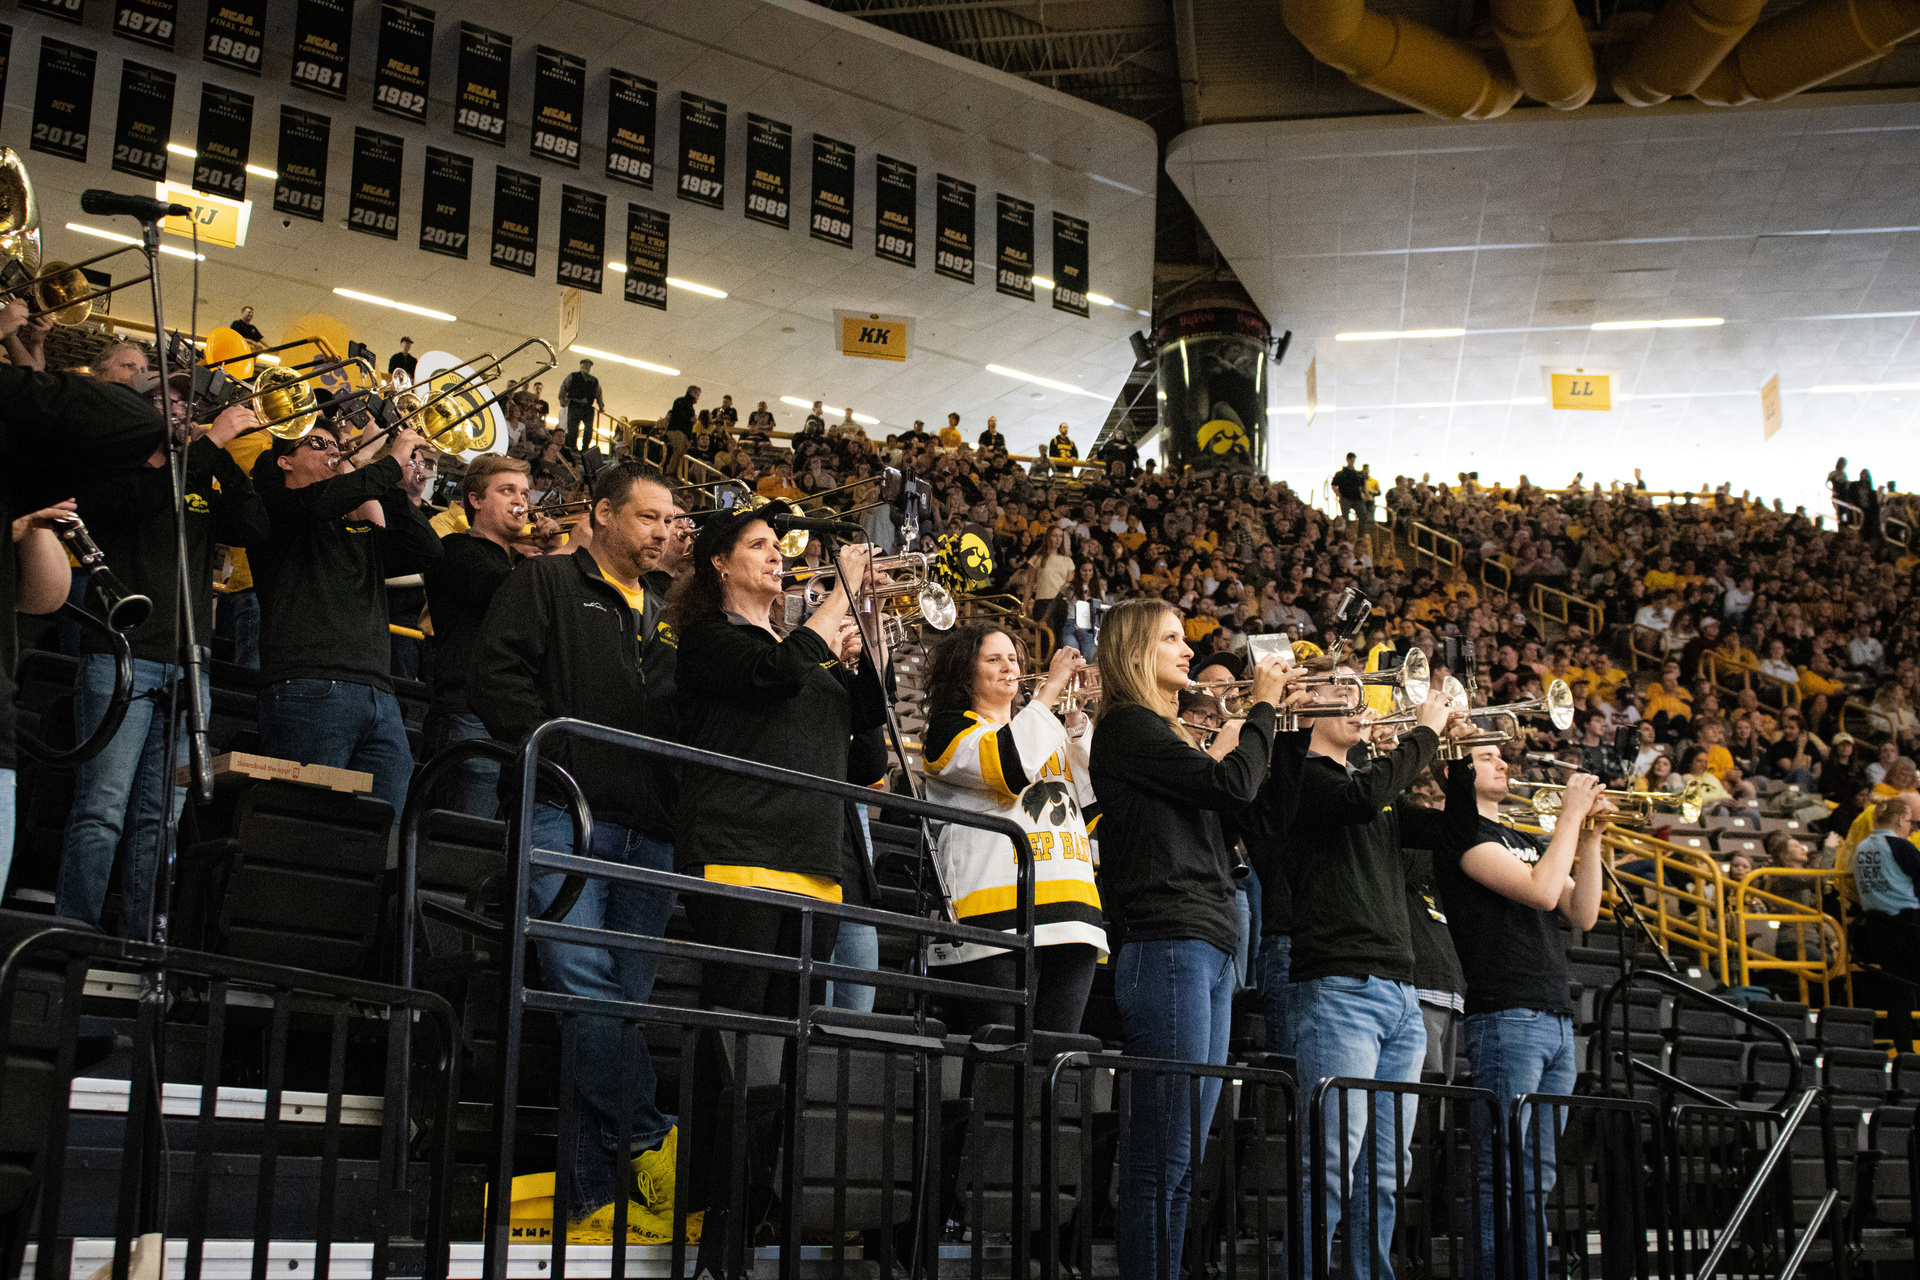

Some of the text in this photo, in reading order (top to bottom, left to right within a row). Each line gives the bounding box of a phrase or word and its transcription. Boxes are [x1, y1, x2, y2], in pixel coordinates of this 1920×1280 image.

[118, 9, 173, 38] 1979
[219, 8, 254, 26] NCAA
[210, 17, 260, 38] FINAL FOUR
[208, 34, 260, 63] 1980
[299, 44, 344, 62] TOURNAMENT
[305, 34, 338, 52] NCAA
[295, 62, 343, 88] 1981
[381, 68, 426, 86] TOURNAMENT
[387, 58, 420, 77] NCAA
[378, 85, 426, 113] 1982
[466, 82, 497, 100] NCAA
[458, 108, 504, 134] 1983
[537, 116, 578, 132] TOURNAMENT
[542, 106, 572, 123] NCAA
[33, 122, 87, 150] 2012
[534, 131, 578, 158] 1985
[616, 128, 645, 144] NCAA
[114, 144, 166, 170] 2013
[208, 142, 238, 158] NCAA
[688, 150, 716, 166] NCAA
[287, 163, 316, 178] NCAA
[608, 153, 652, 178] 1986
[195, 166, 244, 192] 2014
[682, 174, 722, 198] 1987
[755, 170, 782, 186] NCAA
[276, 186, 324, 210] 2015
[361, 184, 390, 198] NCAA
[820, 190, 844, 206] NCAA
[749, 194, 788, 218] 1988
[351, 208, 397, 230] 2016
[502, 220, 529, 236] NCAA
[814, 214, 850, 238] 1989
[883, 210, 908, 226] NCAA
[422, 226, 466, 248] 2017
[568, 238, 595, 252] NCAA
[944, 228, 968, 242] NCAA
[493, 243, 535, 267] 2019
[878, 234, 913, 257] 1991
[1004, 246, 1028, 260] NCAA
[559, 260, 601, 284] 2021
[634, 256, 660, 270] NCAA
[938, 251, 972, 275] 1992
[626, 279, 667, 300] 2022
[999, 269, 1032, 292] 1993
[1055, 286, 1088, 308] 1995
[858, 327, 891, 344] KK
[1571, 381, 1594, 396] LL
[237, 760, 267, 771] Download
[1014, 831, 1054, 862] EP
[1858, 852, 1880, 864] CSC
